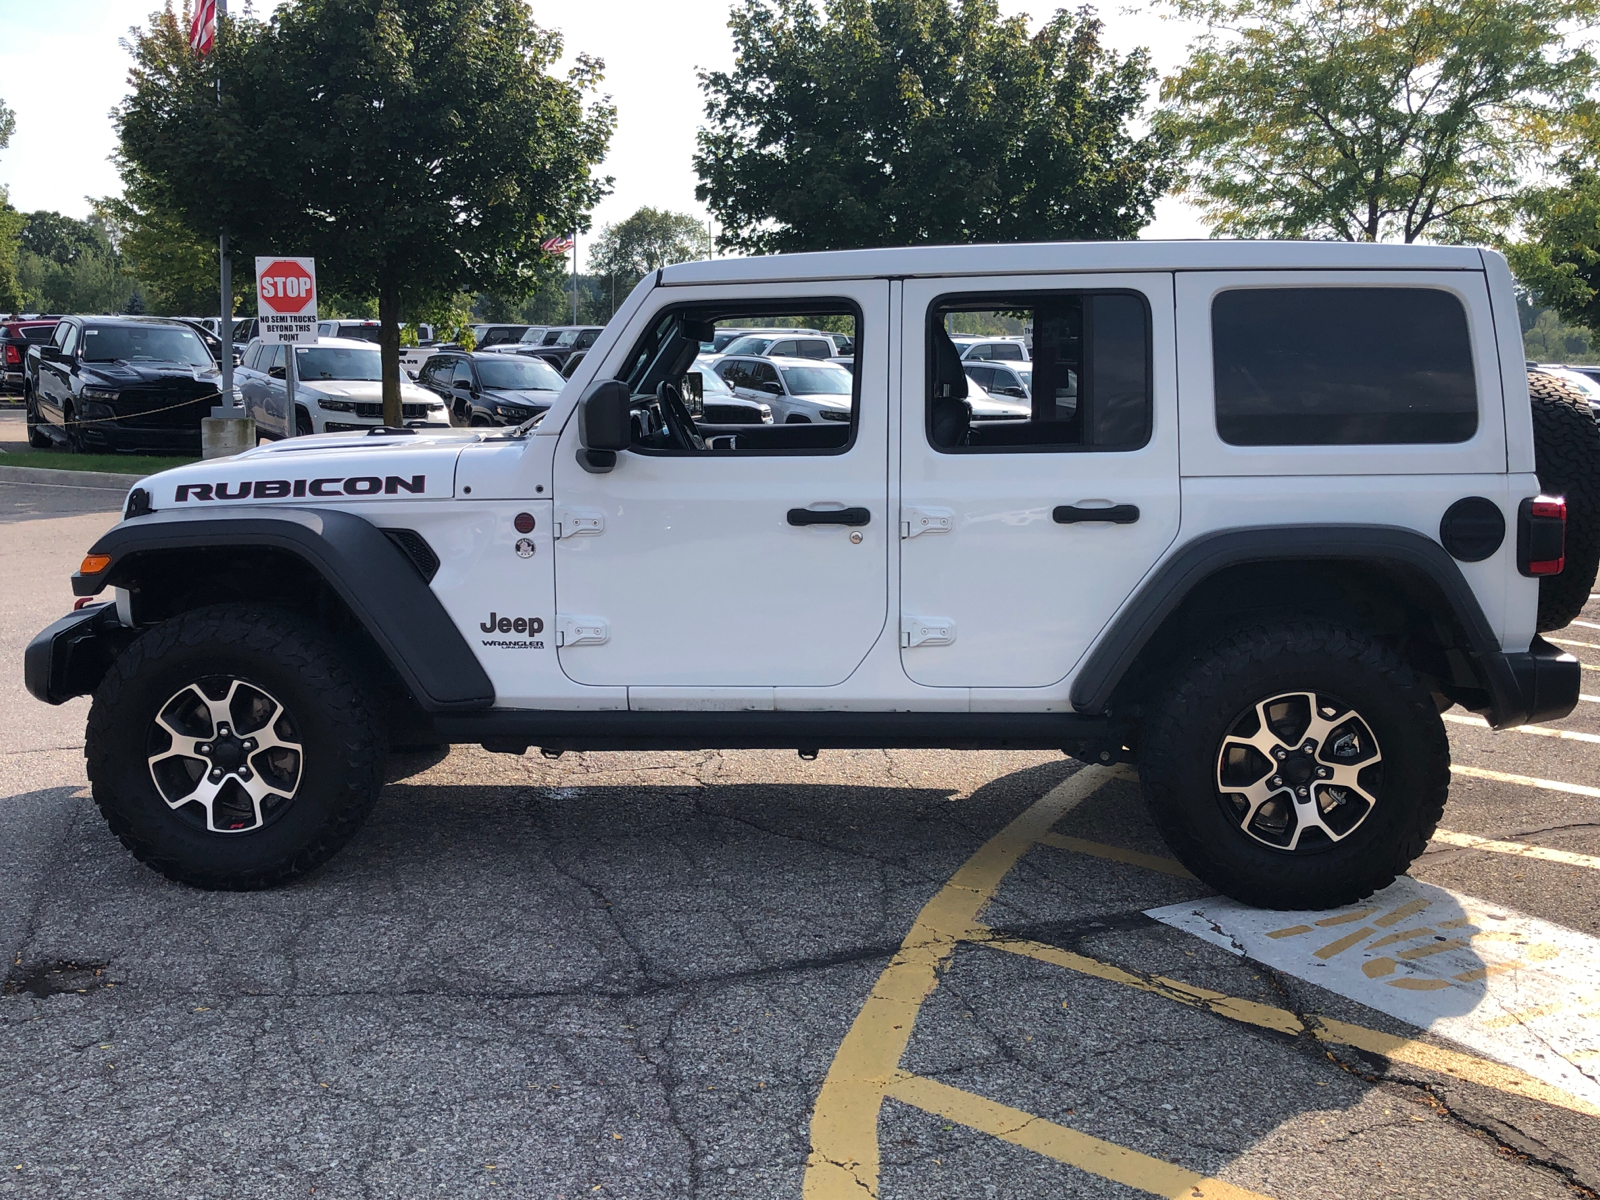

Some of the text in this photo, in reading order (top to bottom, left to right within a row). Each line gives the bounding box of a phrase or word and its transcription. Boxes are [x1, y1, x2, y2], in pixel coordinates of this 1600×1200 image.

[261, 276, 311, 298] STOP
[260, 315, 270, 323] NO
[271, 315, 288, 323] SEMI
[267, 324, 311, 332] BEYOND THIS
[279, 333, 299, 341] POINT
[174, 474, 426, 502] RUBICON
[480, 612, 544, 637] Jeep
